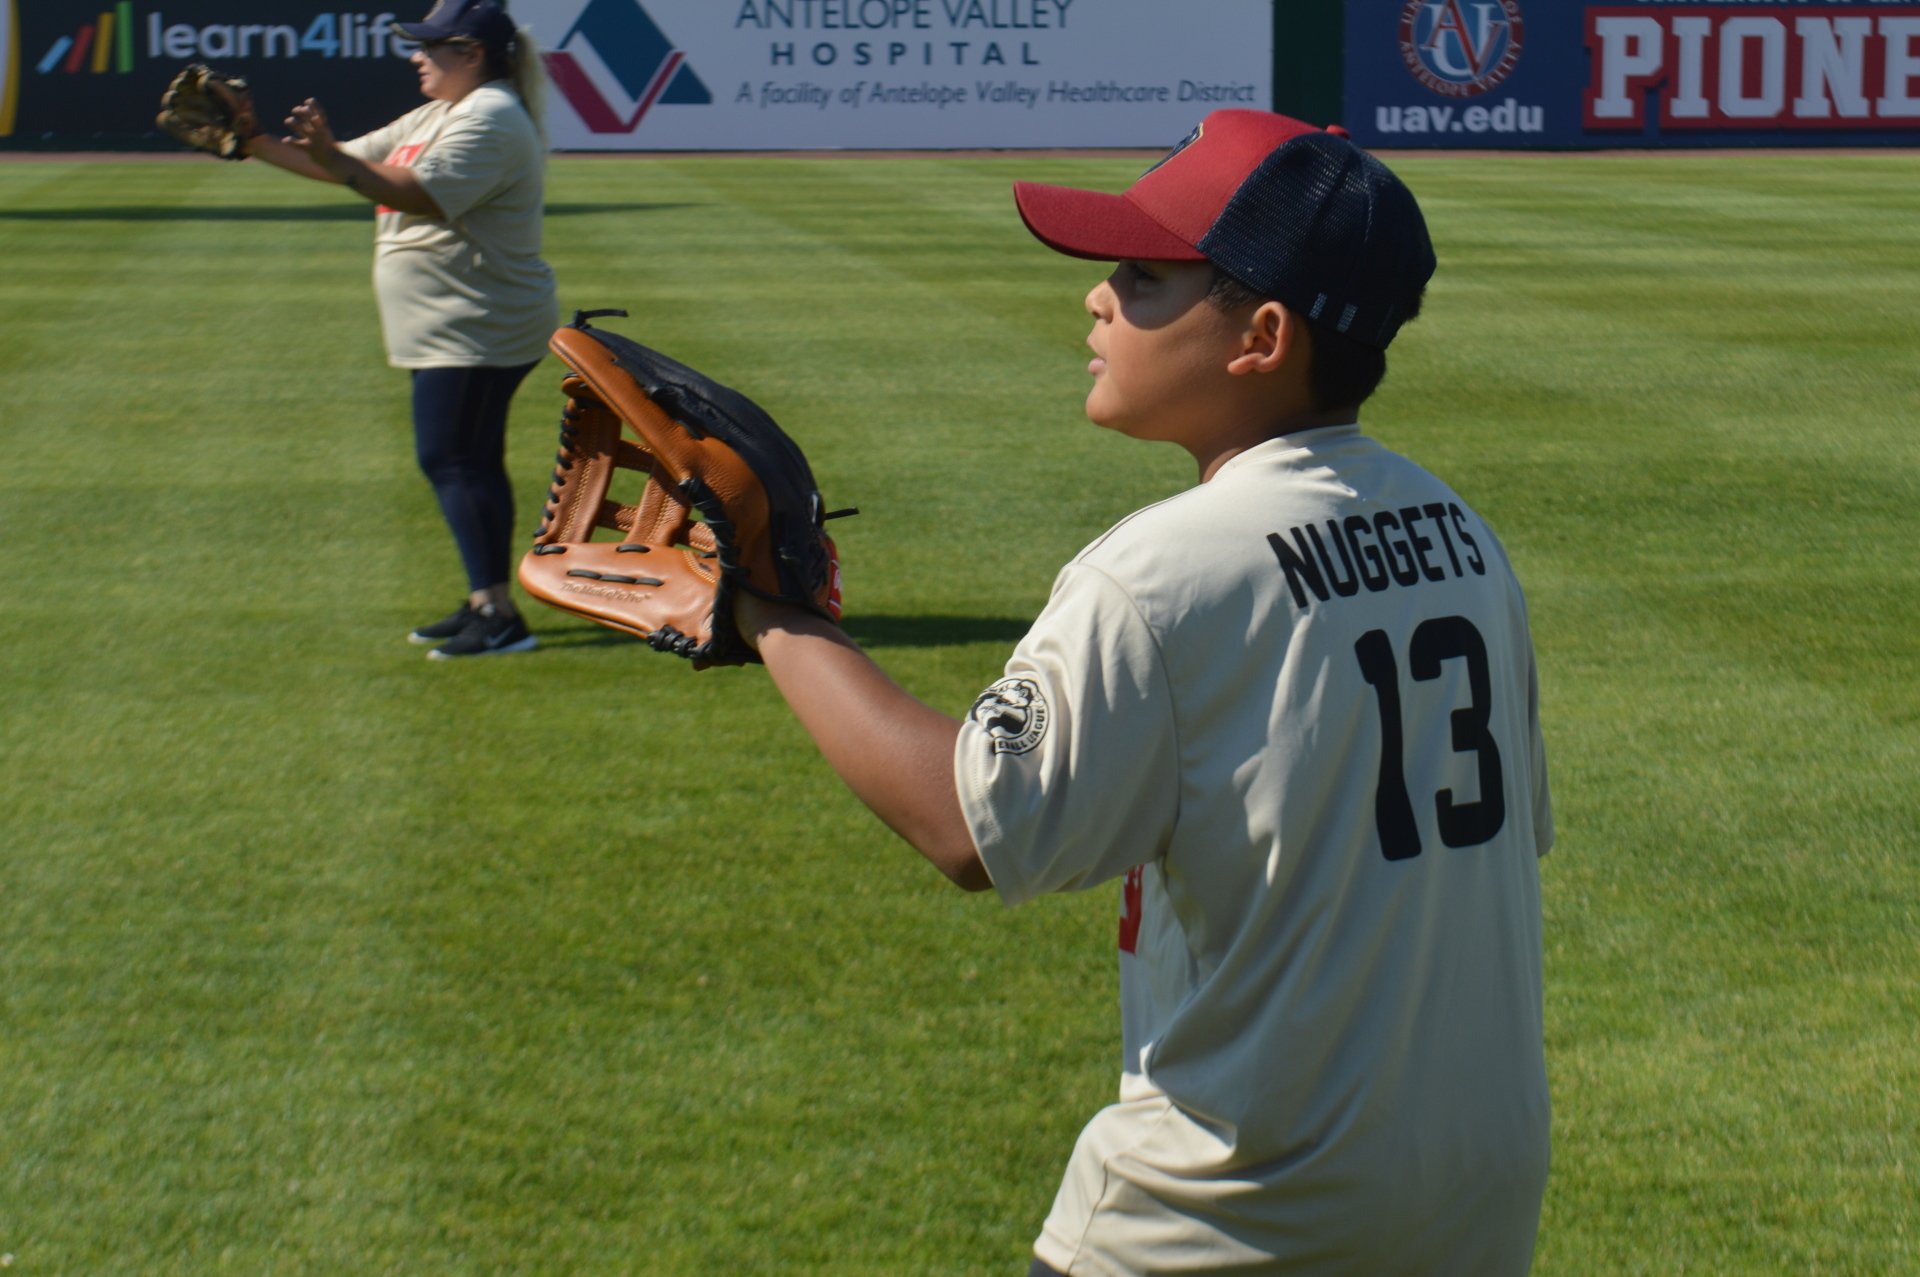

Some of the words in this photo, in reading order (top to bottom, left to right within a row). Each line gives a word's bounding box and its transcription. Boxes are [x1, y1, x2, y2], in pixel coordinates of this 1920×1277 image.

[734, 0, 931, 29] ANTELOPE
[943, 0, 1073, 29] VALLEY
[769, 42, 1040, 66] HOSPITAL
[1594, 16, 1920, 118] PIONE
[734, 81, 754, 104] A
[760, 81, 833, 109] facility
[838, 81, 867, 108] of
[869, 81, 968, 109] Antelope
[976, 81, 1041, 109] Valley
[1048, 81, 1169, 102] Healthcare
[1177, 80, 1256, 102] District
[1376, 97, 1544, 133] uav.edu
[1266, 502, 1485, 609] NUGGETS
[1354, 615, 1505, 861] 13
